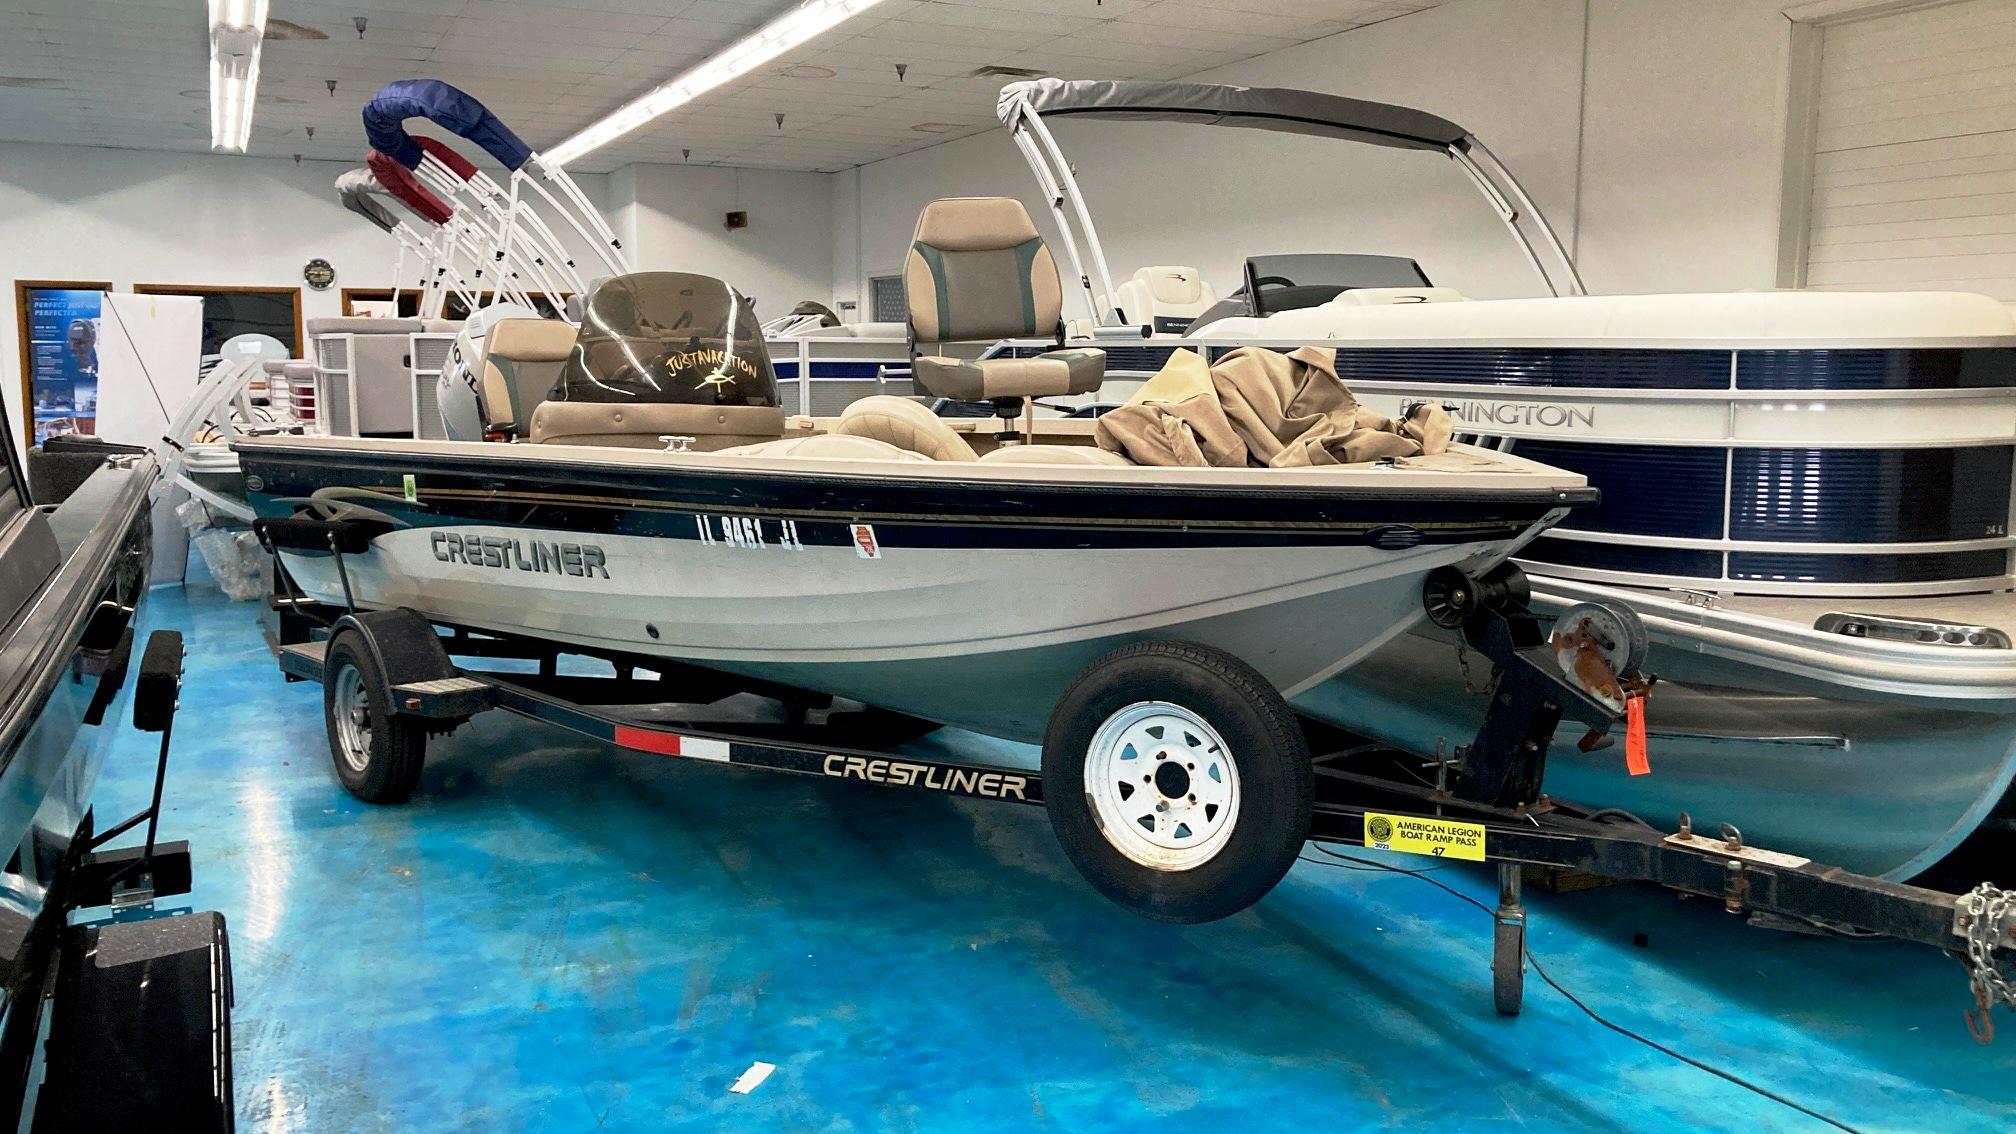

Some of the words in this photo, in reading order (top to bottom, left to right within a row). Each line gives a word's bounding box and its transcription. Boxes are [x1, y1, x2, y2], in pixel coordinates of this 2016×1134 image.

[1400, 398, 1595, 428] BNINGTON
[430, 530, 610, 580] CRESTLINER
[822, 754, 1026, 800] CRESTLINER
[1397, 822, 1445, 834] AMERICAN
[1447, 827, 1481, 838] LEGION
[1400, 831, 1424, 840] BOAT
[1426, 833, 1453, 843] RAMP
[1456, 837, 1477, 847] PASS
[1431, 847, 1446, 856] 47
